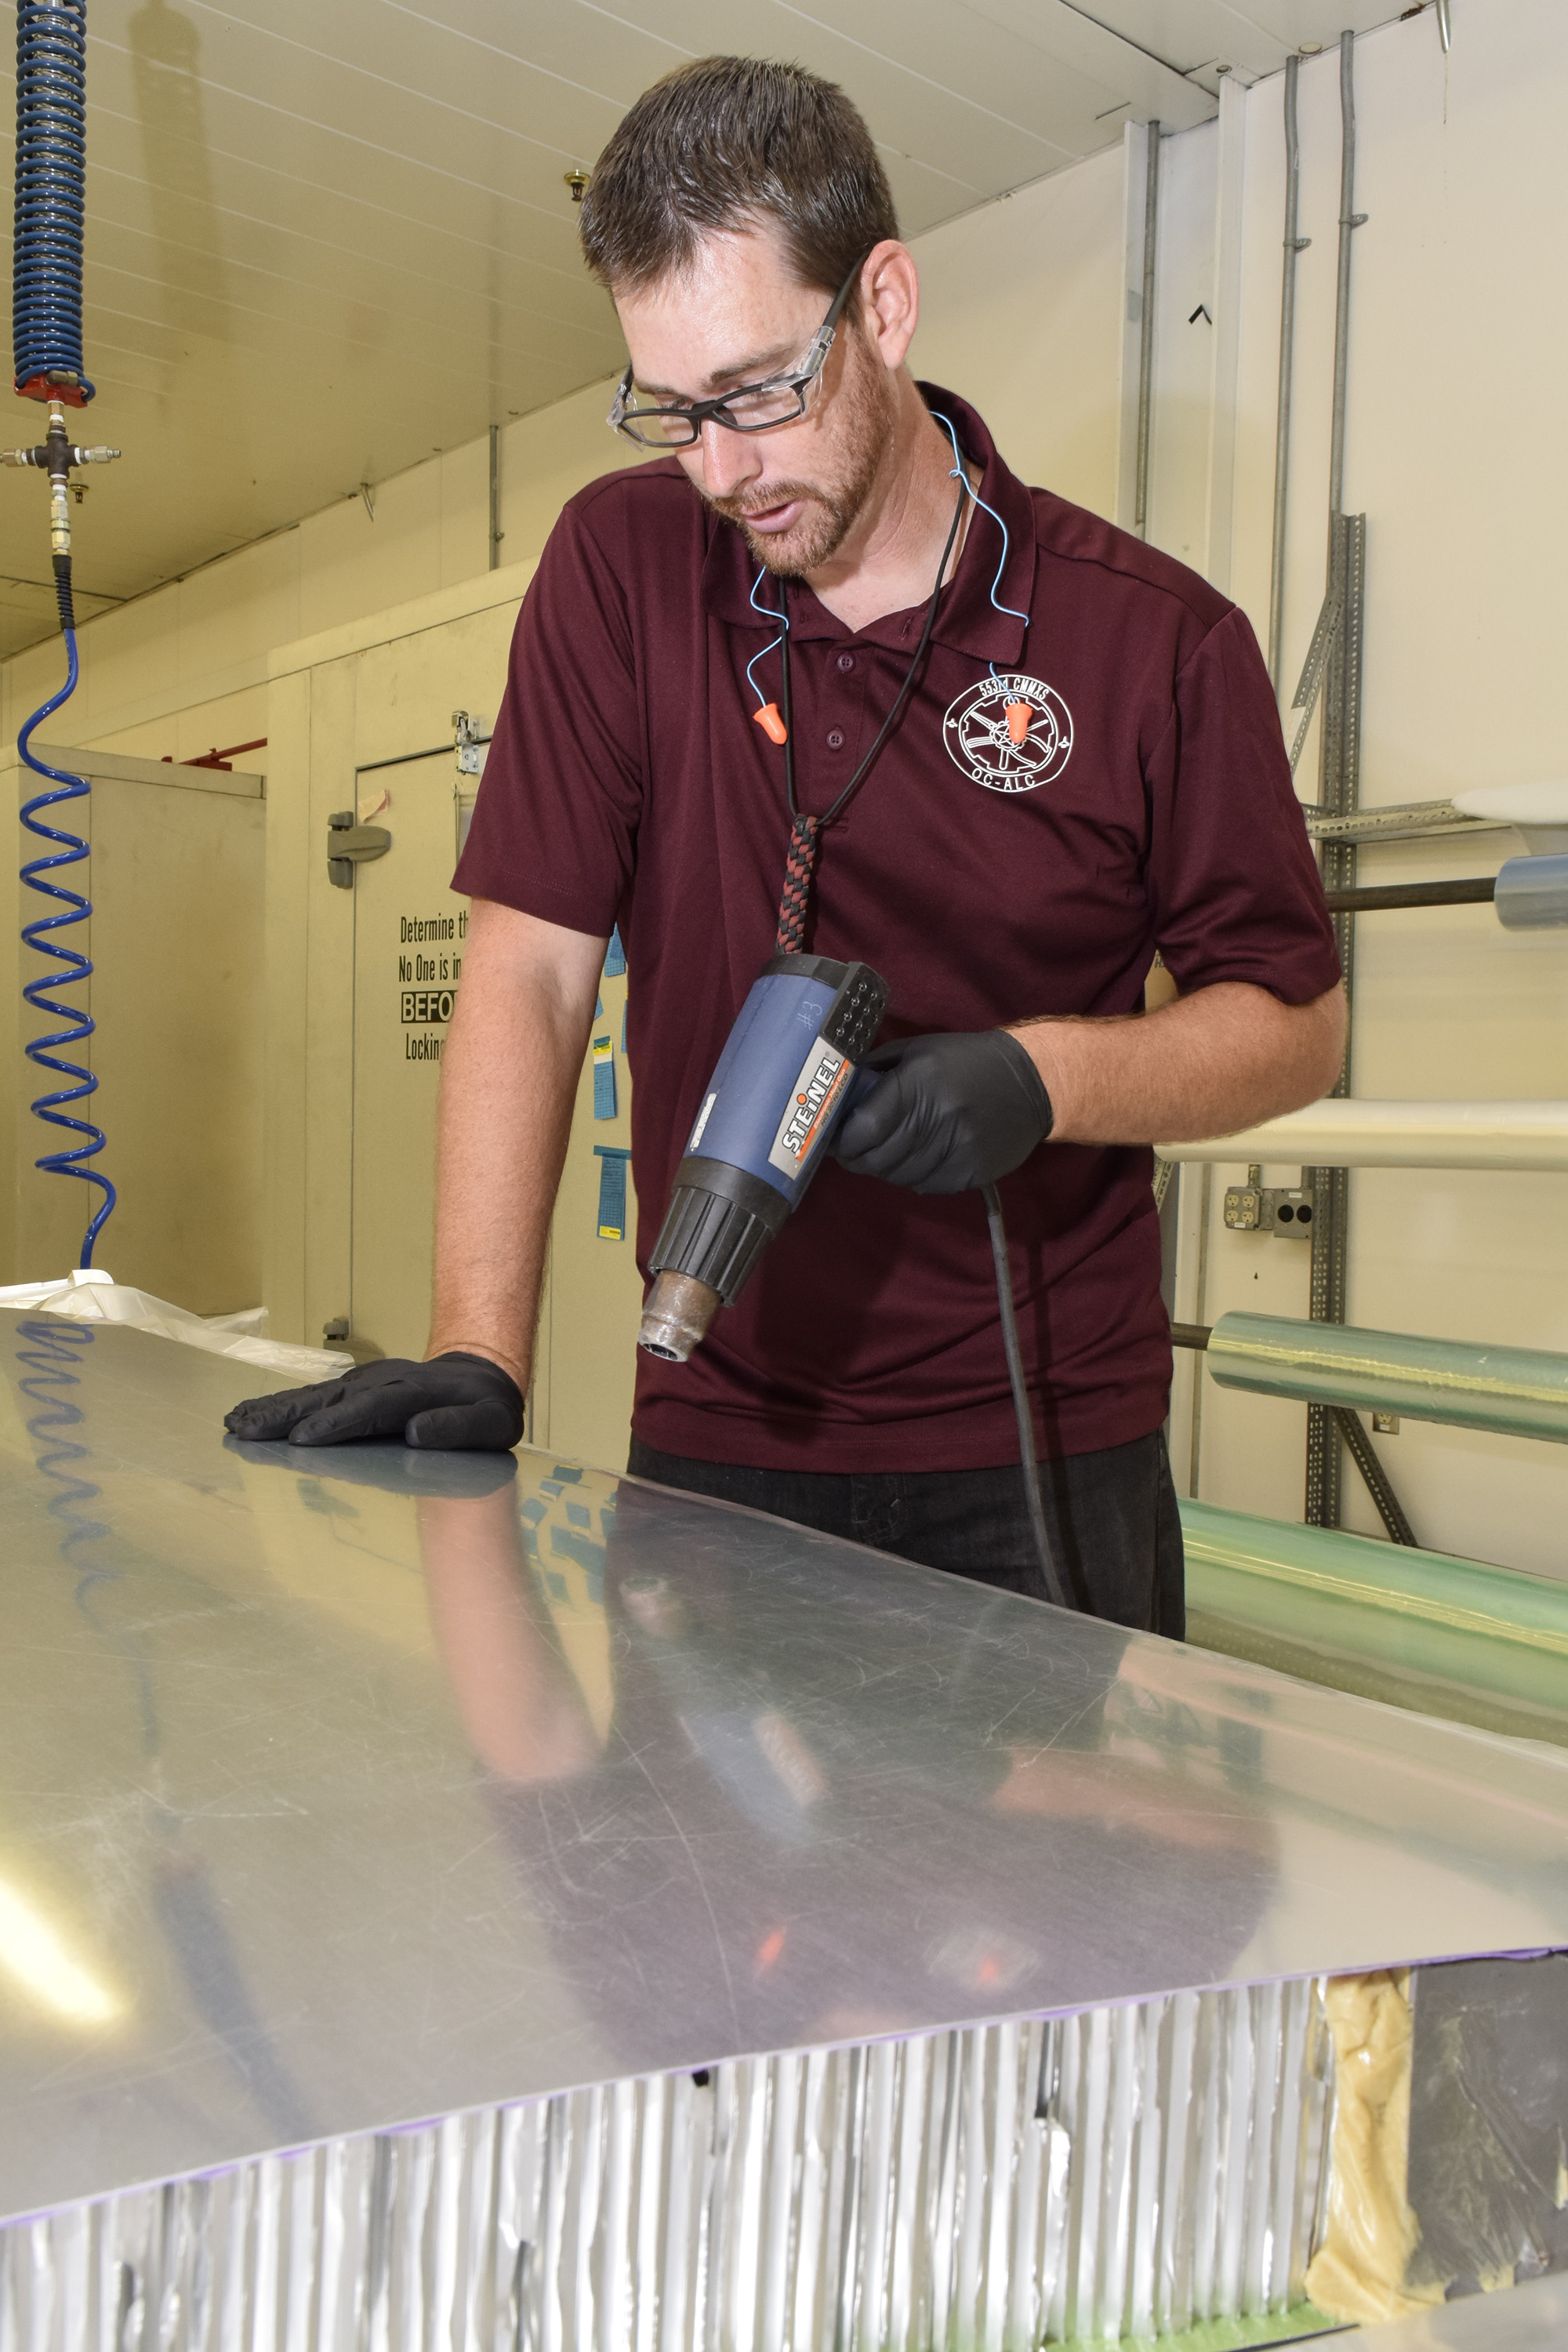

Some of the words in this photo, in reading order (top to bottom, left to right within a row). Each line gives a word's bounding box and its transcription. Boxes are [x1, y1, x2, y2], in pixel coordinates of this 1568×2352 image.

[1013, 677, 1050, 700] CMMXS
[971, 768, 1036, 790] OC-ALC
[400, 913, 454, 943] Determine
[398, 955, 412, 982] No
[416, 953, 435, 982] One
[439, 953, 448, 981] is
[402, 991, 458, 1022] BEFO
[797, 1000, 822, 1030] #3
